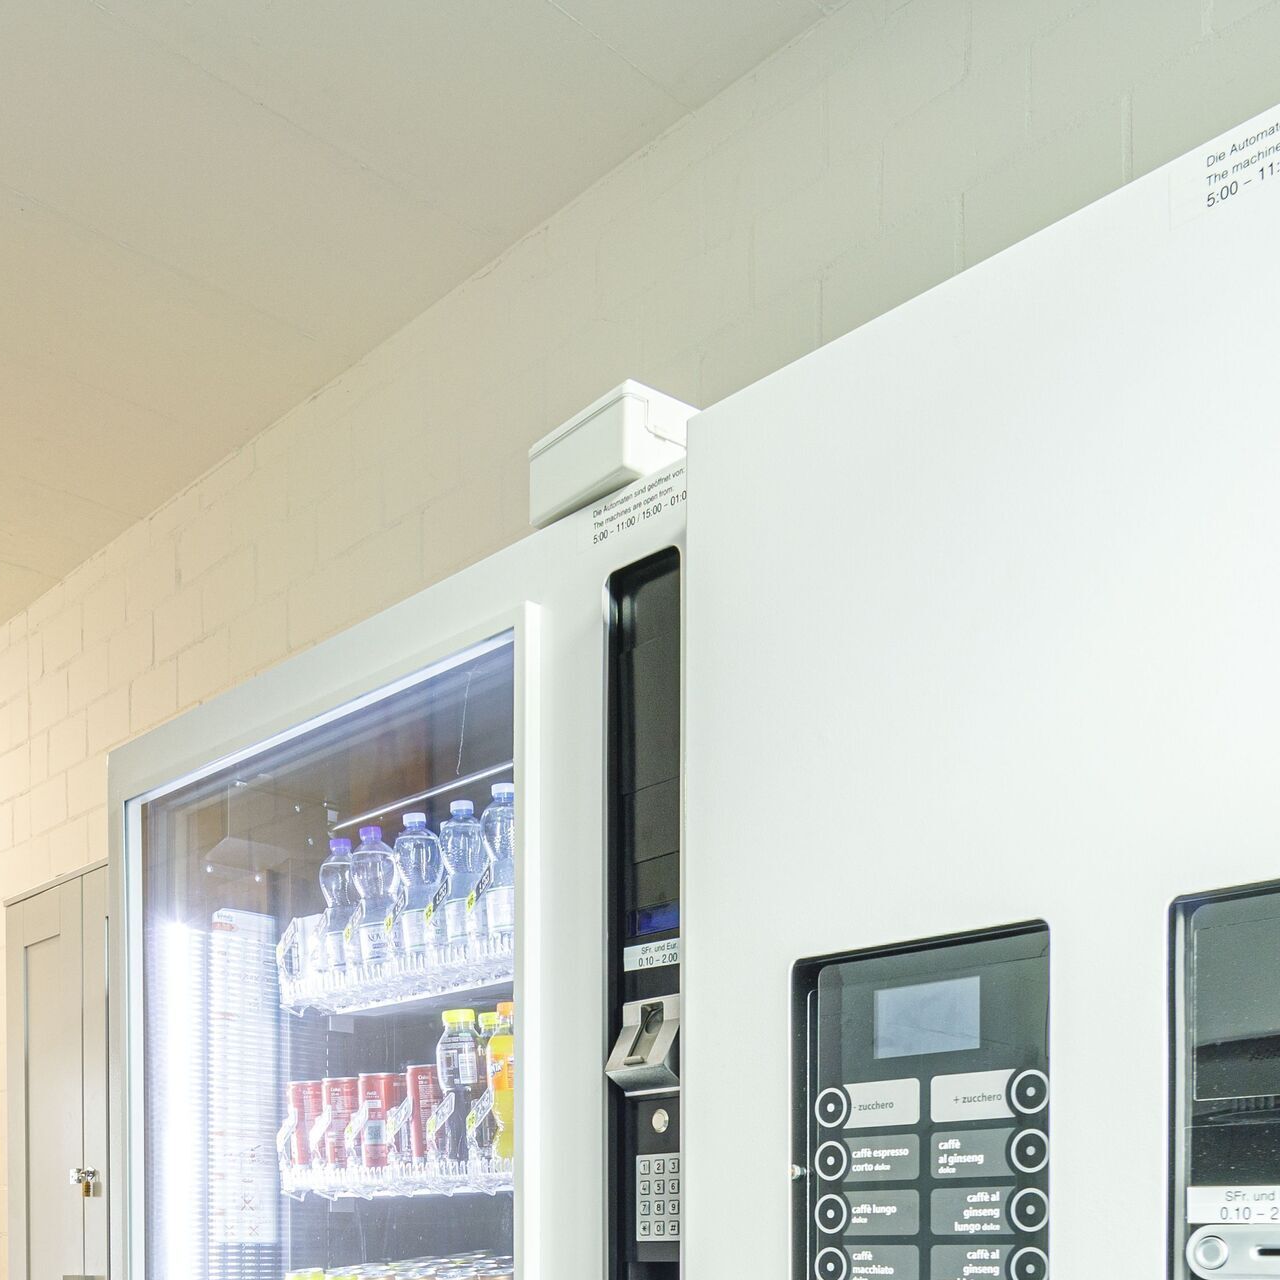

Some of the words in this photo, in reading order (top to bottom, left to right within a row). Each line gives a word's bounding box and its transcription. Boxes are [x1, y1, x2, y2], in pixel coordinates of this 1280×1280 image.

[1206, 151, 1225, 168] Die
[1206, 169, 1228, 186] The
[1207, 180, 1238, 207] 5:00
[593, 509, 602, 518] Die
[604, 493, 633, 512] Automaten
[634, 485, 646, 498] sind
[593, 520, 604, 530] The
[605, 505, 631, 524] machines
[633, 501, 642, 511] are
[643, 492, 658, 506] open
[593, 530, 608, 544] 5:00
[616, 515, 635, 533] 11:00
[642, 502, 662, 520] 15:00
[670, 490, 687, 506] 01:0
[639, 955, 654, 967] 0.10
[662, 952, 678, 963] 2.00
[962, 1092, 1002, 1105] zucchero
[858, 1101, 894, 1111] zucchero
[939, 1139, 960, 1150] caffè
[852, 1148, 871, 1158] caffè
[873, 1148, 908, 1159] espresso
[939, 1154, 947, 1163] al
[949, 1152, 983, 1166] ginseng
[852, 1162, 873, 1172] corto
[657, 1183, 661, 1191] 5
[967, 1192, 989, 1202] caffè
[991, 1192, 999, 1202] al
[1225, 1191, 1249, 1201] SFr.
[1253, 1191, 1275, 1201] und
[852, 1205, 871, 1214] caffè
[873, 1204, 896, 1216] lungo
[963, 1206, 1000, 1219] ginseng
[1220, 1207, 1251, 1220] 0.10
[955, 1222, 980, 1233] lungo
[853, 1252, 872, 1261] caffè
[967, 1250, 989, 1260] caffè
[991, 1250, 999, 1259] al
[852, 1265, 893, 1275] macchiato
[963, 1264, 999, 1276] ginseng
